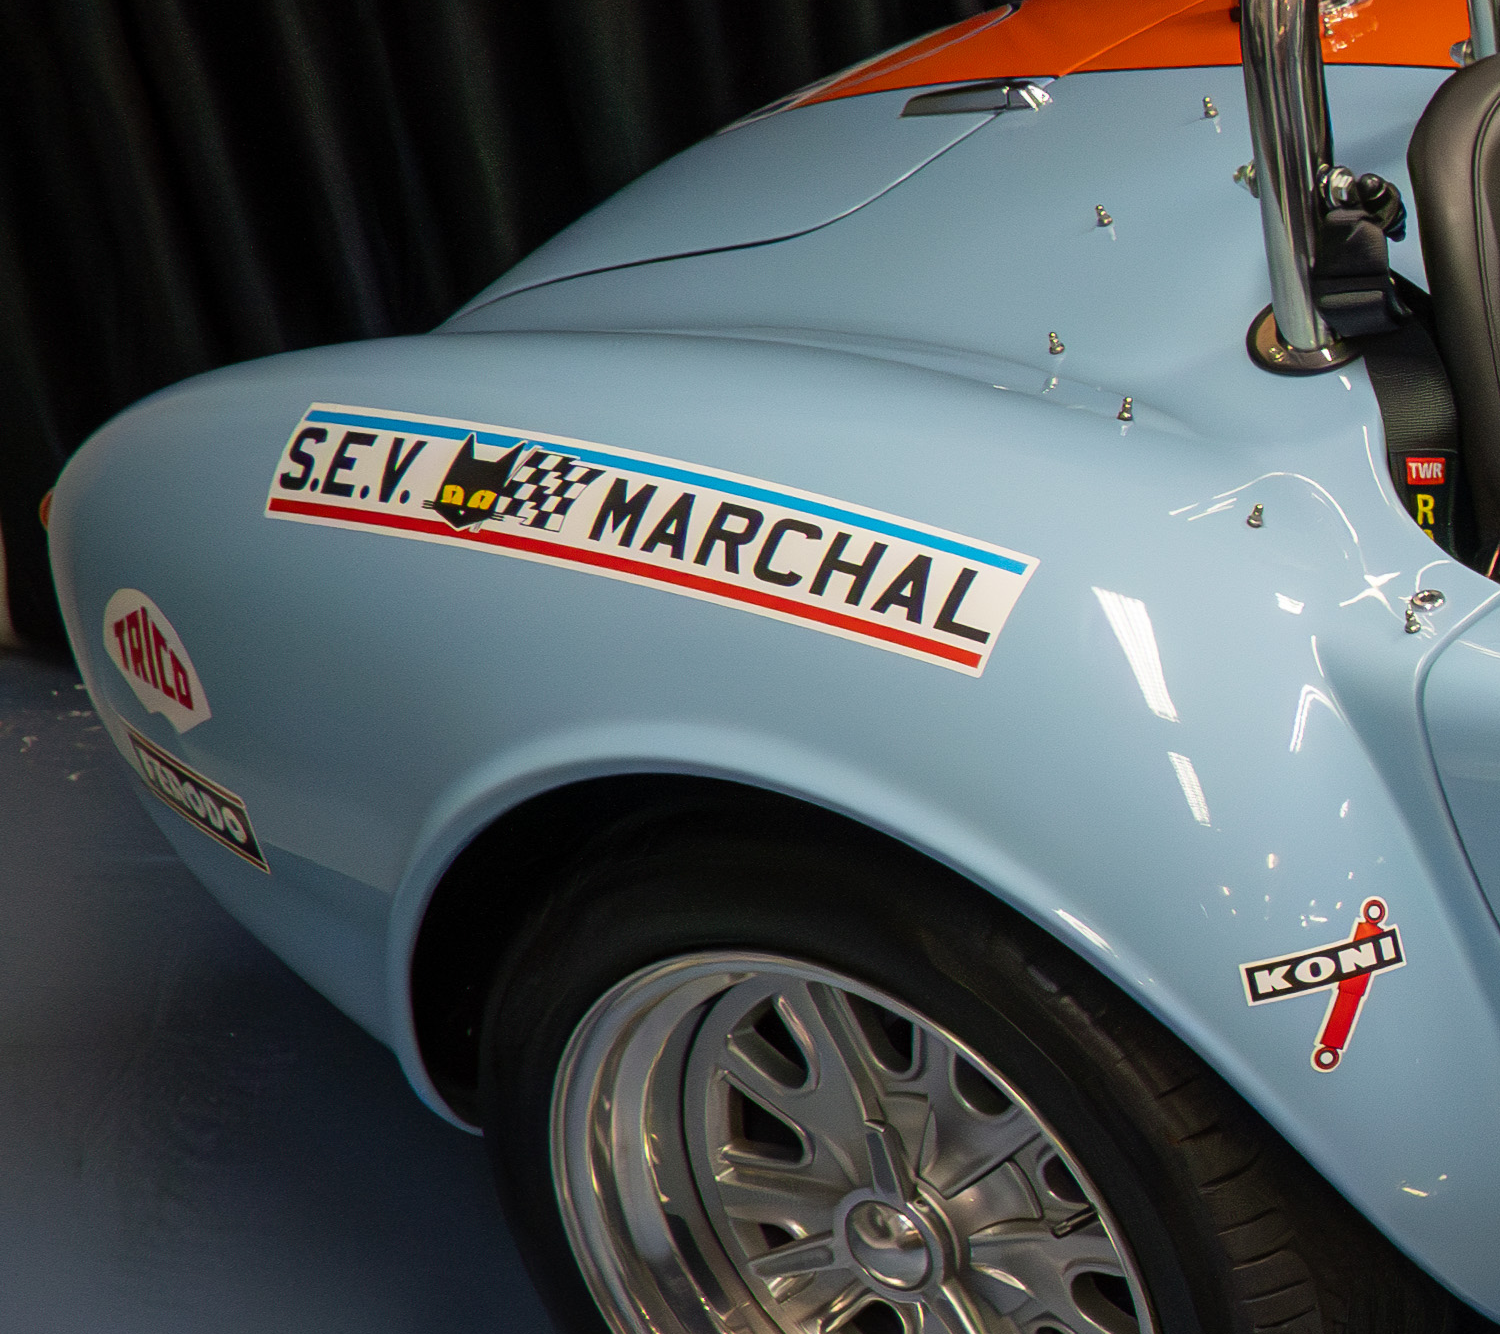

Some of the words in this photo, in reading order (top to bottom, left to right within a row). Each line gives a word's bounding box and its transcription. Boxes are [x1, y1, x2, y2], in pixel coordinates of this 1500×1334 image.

[1407, 462, 1443, 479] TWR
[278, 426, 427, 505] S.E.V.
[587, 477, 991, 644] MARCHAL
[113, 606, 194, 711] TRICO
[134, 745, 247, 845] FERODO
[1254, 936, 1396, 994] KONI
